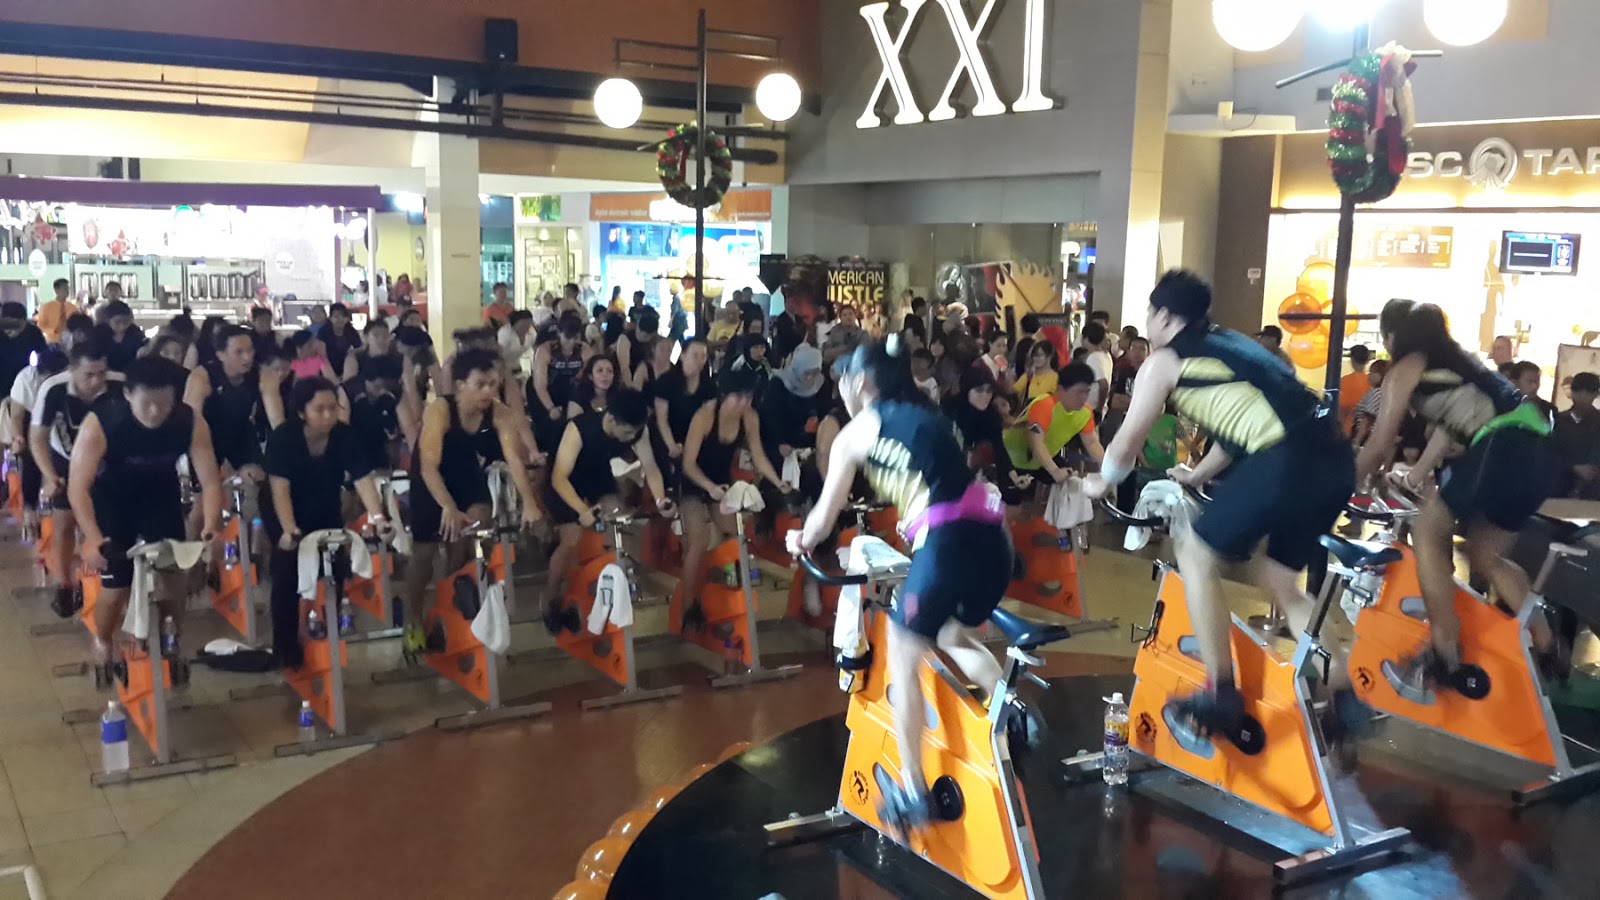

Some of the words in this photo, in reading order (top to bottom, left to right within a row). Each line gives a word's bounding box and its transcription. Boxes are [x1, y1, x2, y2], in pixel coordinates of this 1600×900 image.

[856, 0, 1054, 129] XXI
[1407, 151, 1463, 178] SC
[827, 270, 885, 285] MERICAN
[827, 285, 885, 305] USTLE
